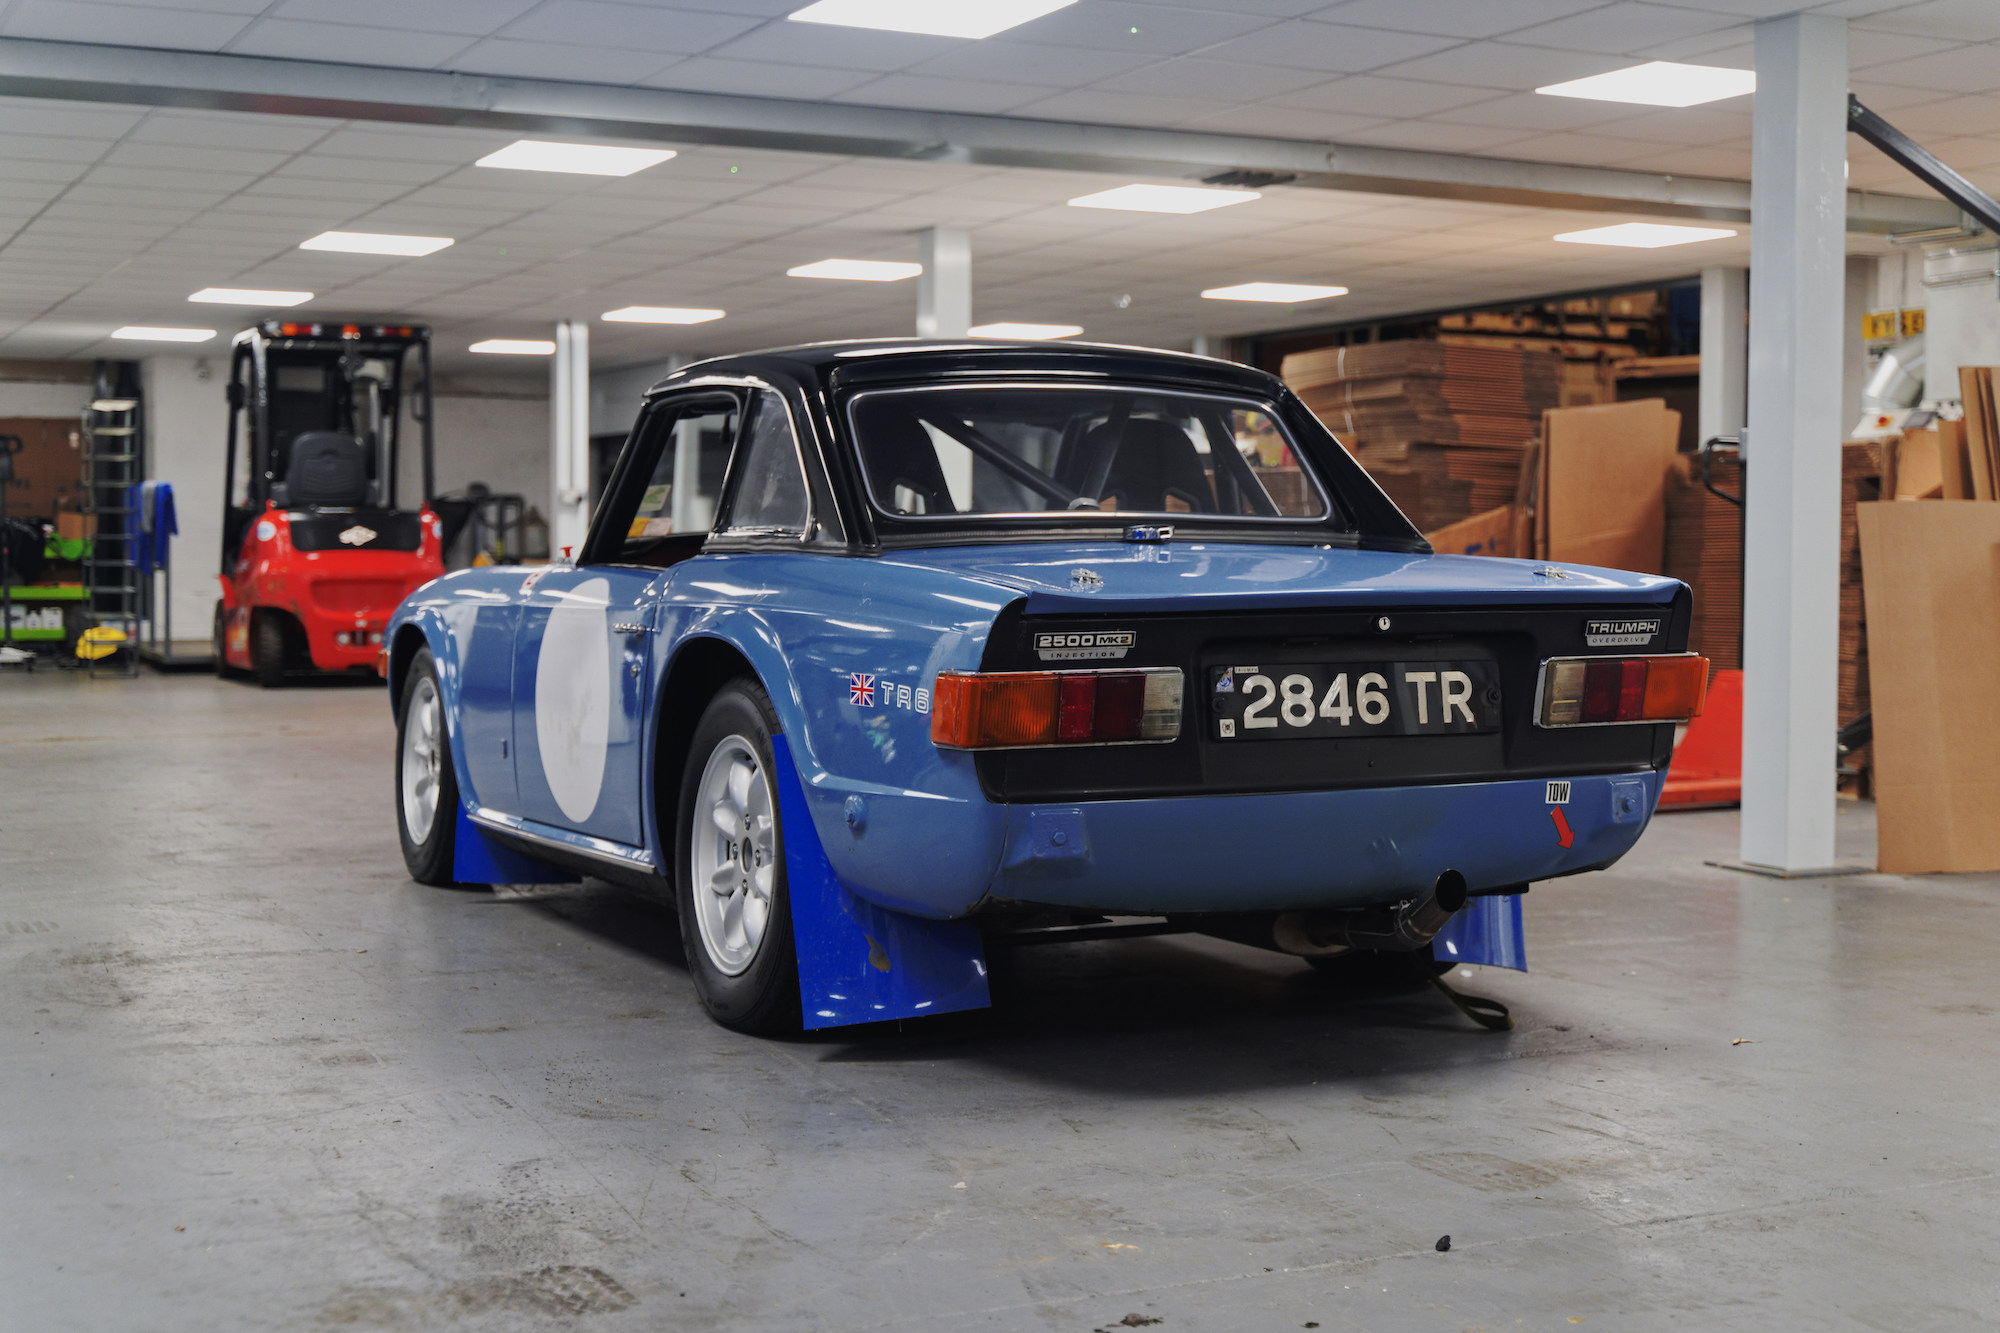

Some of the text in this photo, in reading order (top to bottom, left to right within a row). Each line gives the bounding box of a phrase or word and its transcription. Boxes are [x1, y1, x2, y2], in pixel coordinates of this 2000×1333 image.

[1590, 622, 1657, 634] TRIUMPH
[1039, 635, 1129, 647] 2500 MK2
[881, 681, 929, 714] TR6
[1242, 671, 1475, 729] 2846 TR
[1548, 783, 1569, 802] TOW
